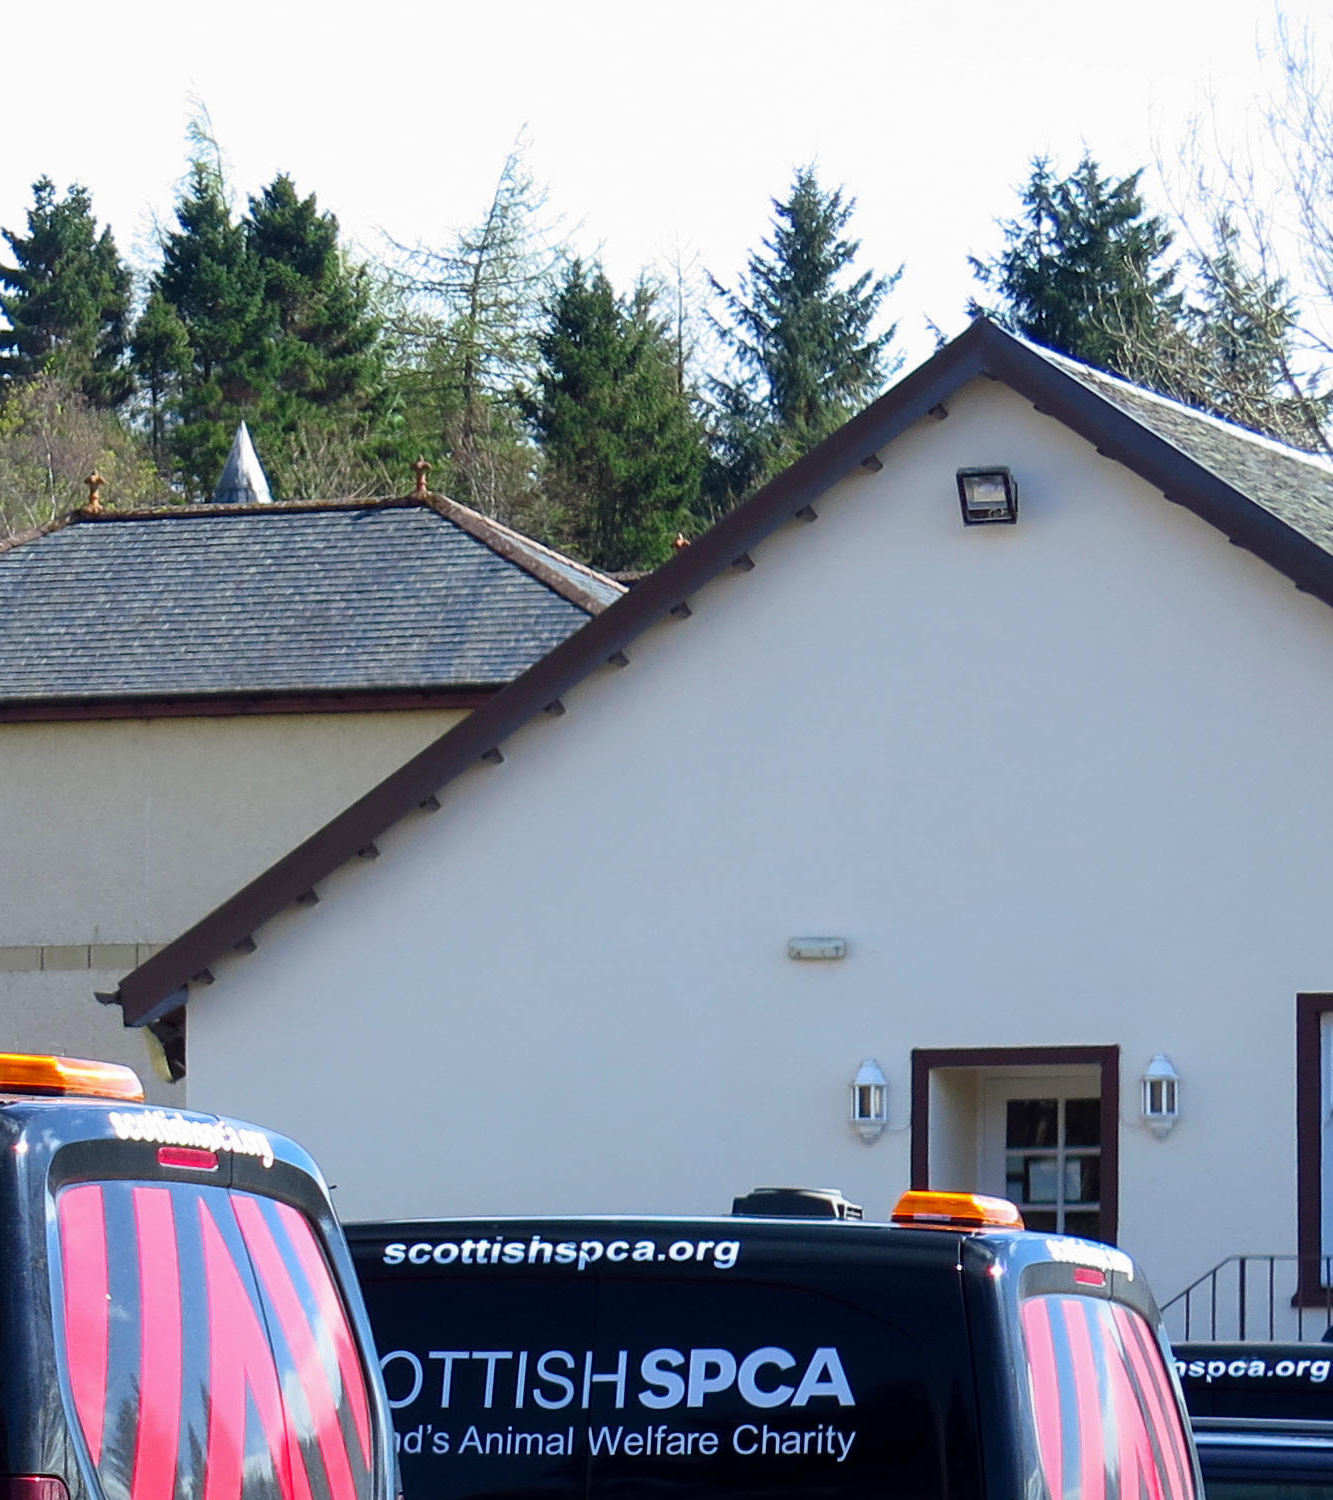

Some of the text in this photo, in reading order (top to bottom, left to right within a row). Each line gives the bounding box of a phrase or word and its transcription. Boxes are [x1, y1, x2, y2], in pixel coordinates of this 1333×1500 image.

[382, 1235, 741, 1271] scottishspca.org
[457, 1425, 574, 1456] Animal
[587, 1425, 719, 1457] Welfare
[732, 1423, 857, 1464] Charity
